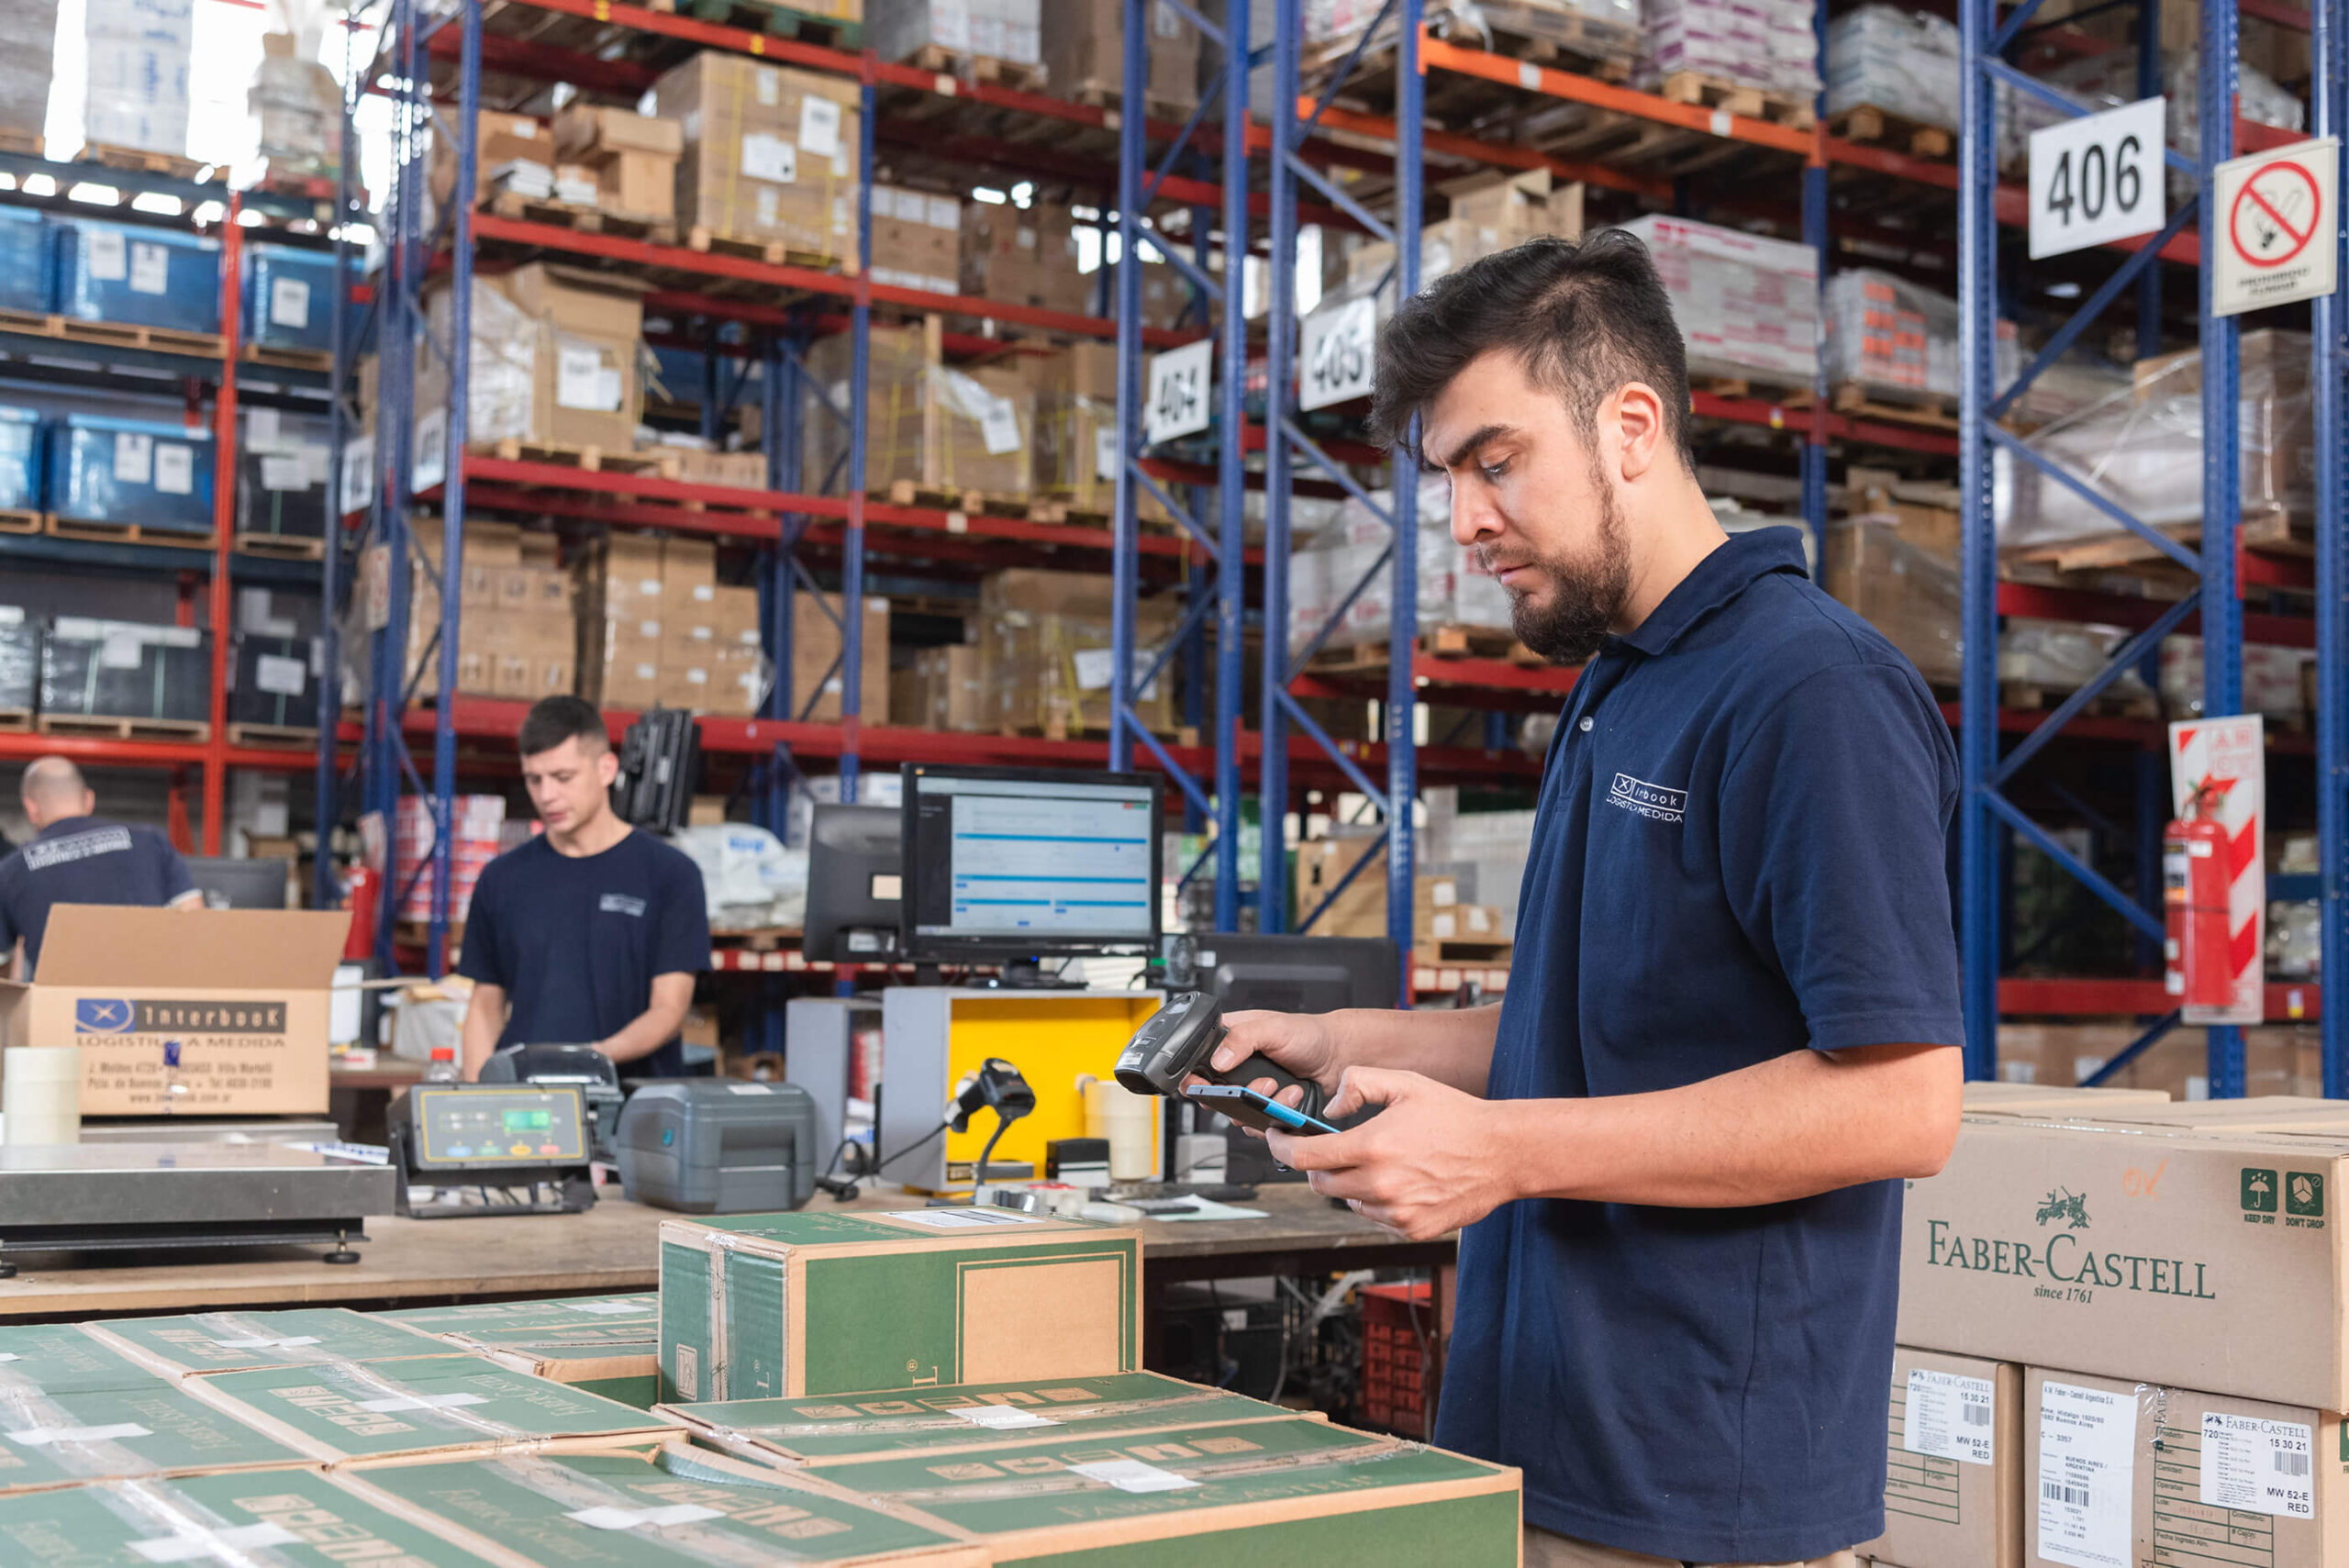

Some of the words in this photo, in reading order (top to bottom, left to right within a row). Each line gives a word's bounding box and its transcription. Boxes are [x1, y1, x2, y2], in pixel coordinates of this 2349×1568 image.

[2047, 135, 2141, 226] 406
[1158, 365, 1197, 427] 404
[206, 1038, 285, 1048] MEDIDA
[2244, 1214, 2261, 1223] KEEP
[2263, 1215, 2276, 1225] DRY
[2285, 1217, 2305, 1228] DON'T
[2307, 1219, 2325, 1229] DROP
[1926, 1218, 2216, 1300] FABER-CASTELL
[2033, 1284, 2063, 1300] since
[2065, 1287, 2093, 1304] 1761
[1981, 1396, 1989, 1404] 21
[2203, 1429, 2219, 1439] 720
[1956, 1436, 1970, 1445] MW
[2269, 1438, 2280, 1448] 15
[2282, 1440, 2293, 1449] 30
[2296, 1441, 2307, 1451] 21
[1972, 1450, 1990, 1460] RED
[2266, 1487, 2284, 1497] MW
[2287, 1490, 2309, 1501] 52-E
[2288, 1502, 2310, 1514] RED
